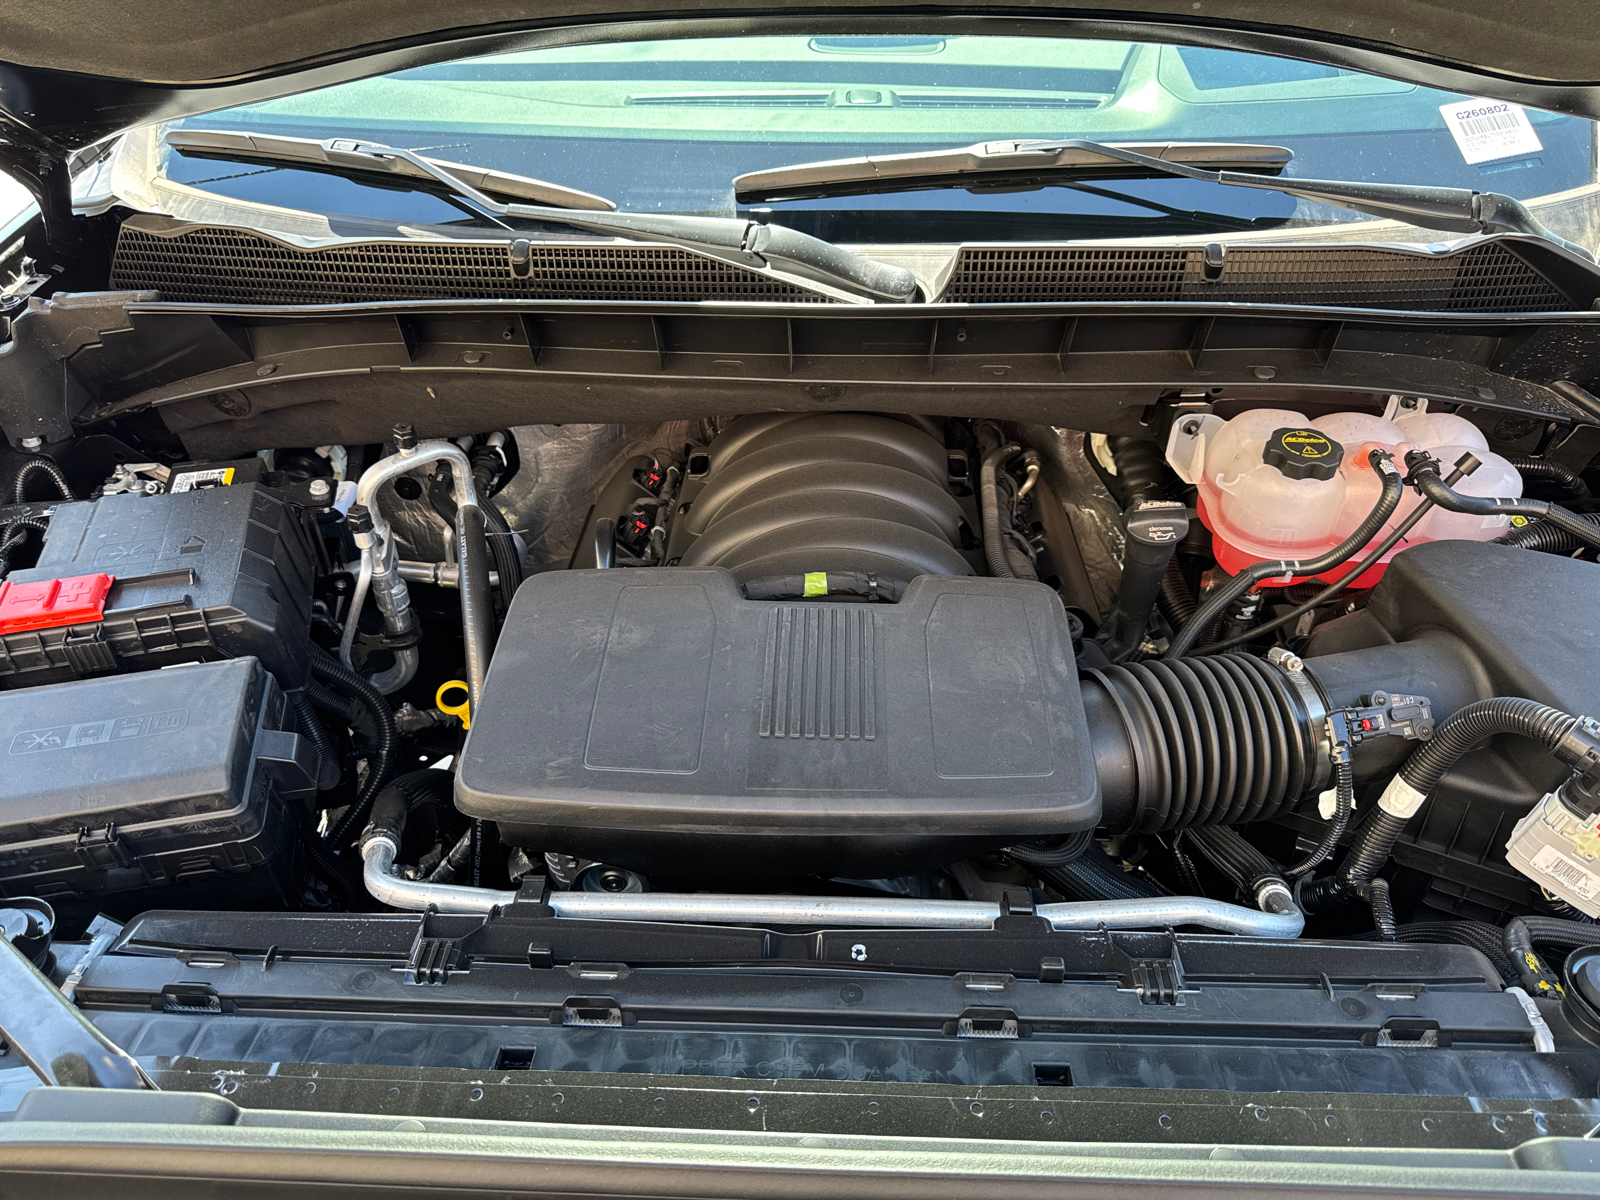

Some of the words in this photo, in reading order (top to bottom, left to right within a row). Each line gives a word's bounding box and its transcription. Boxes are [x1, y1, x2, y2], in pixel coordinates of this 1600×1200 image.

[1456, 104, 1509, 120] G260802
[1139, 501, 1182, 510] ACDelco
[460, 535, 469, 558] GALAXY
[664, 1059, 748, 1077] UPPER
